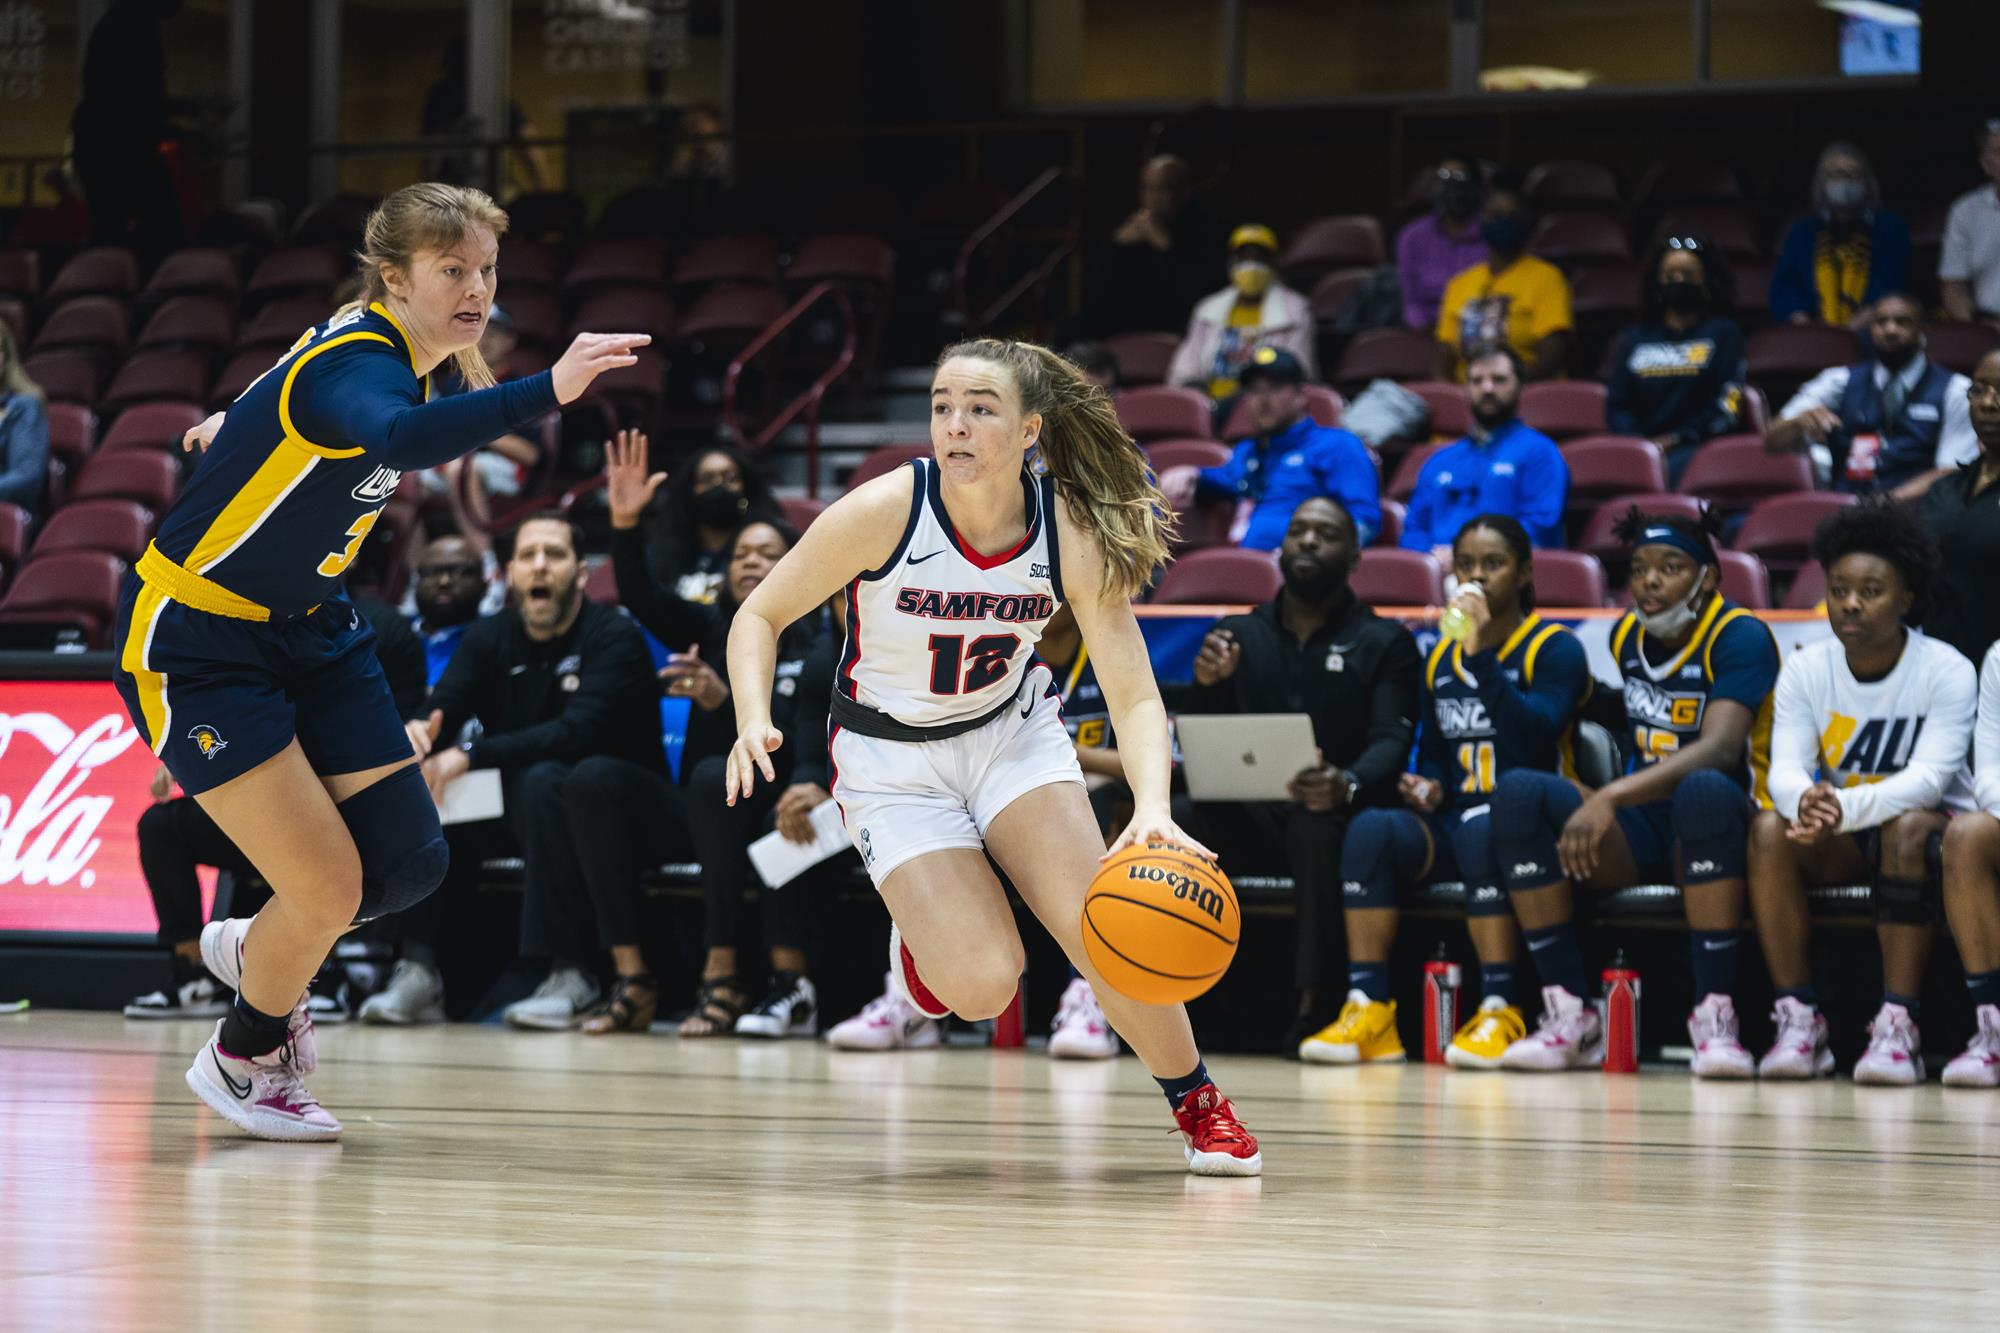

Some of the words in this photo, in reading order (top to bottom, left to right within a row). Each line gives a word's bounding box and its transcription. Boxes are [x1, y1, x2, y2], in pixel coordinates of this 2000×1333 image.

[895, 587, 1054, 623] SAMFORD
[928, 633, 1022, 695] 12
[1128, 864, 1225, 924] Wilson
